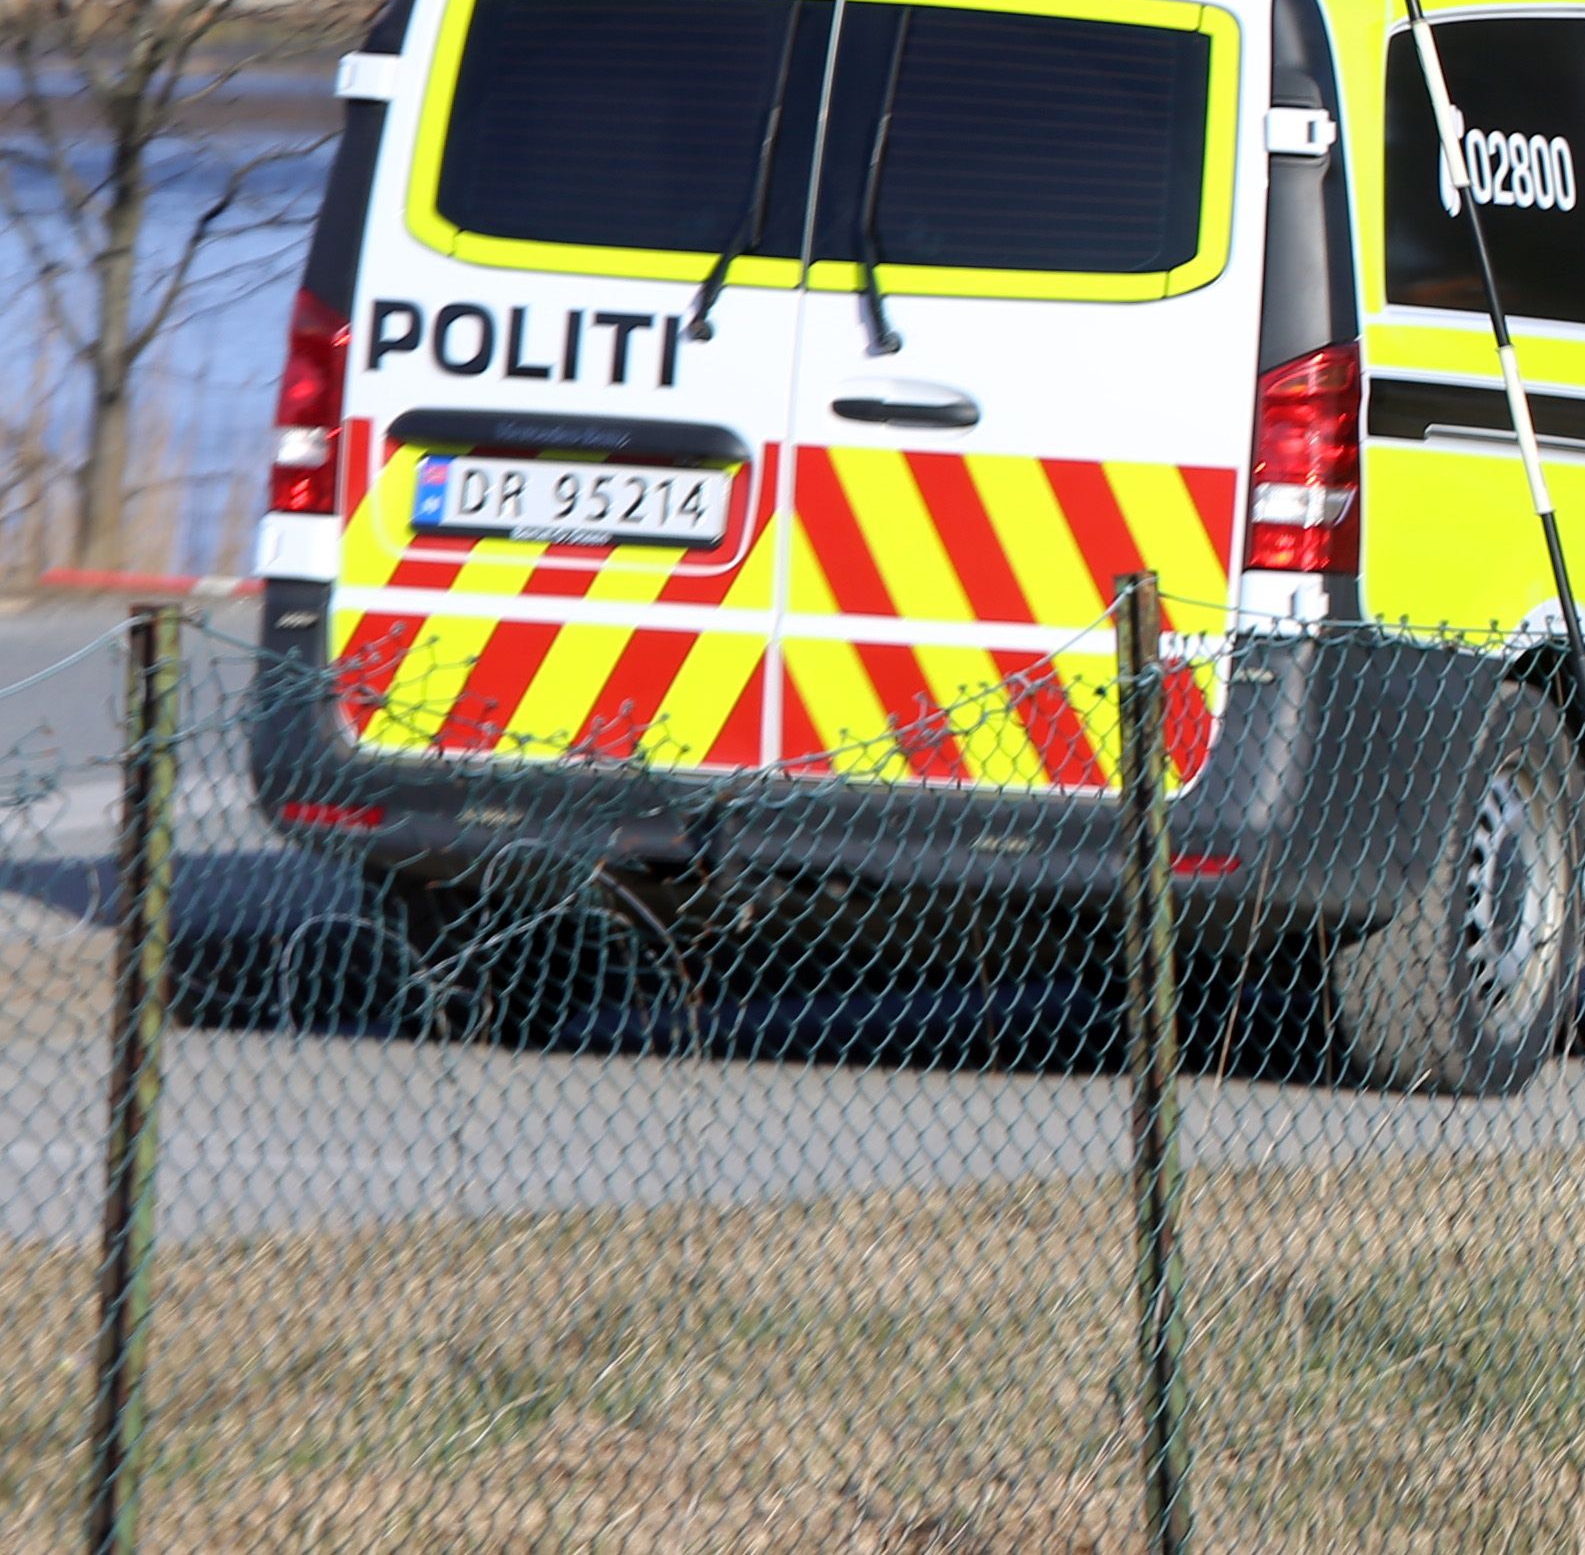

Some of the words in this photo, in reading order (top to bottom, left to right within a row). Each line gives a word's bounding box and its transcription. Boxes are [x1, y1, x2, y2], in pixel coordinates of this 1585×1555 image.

[1464, 127, 1577, 212] 02800
[364, 298, 683, 388] POLITI
[458, 467, 526, 519] DR
[549, 472, 708, 528] 95214
